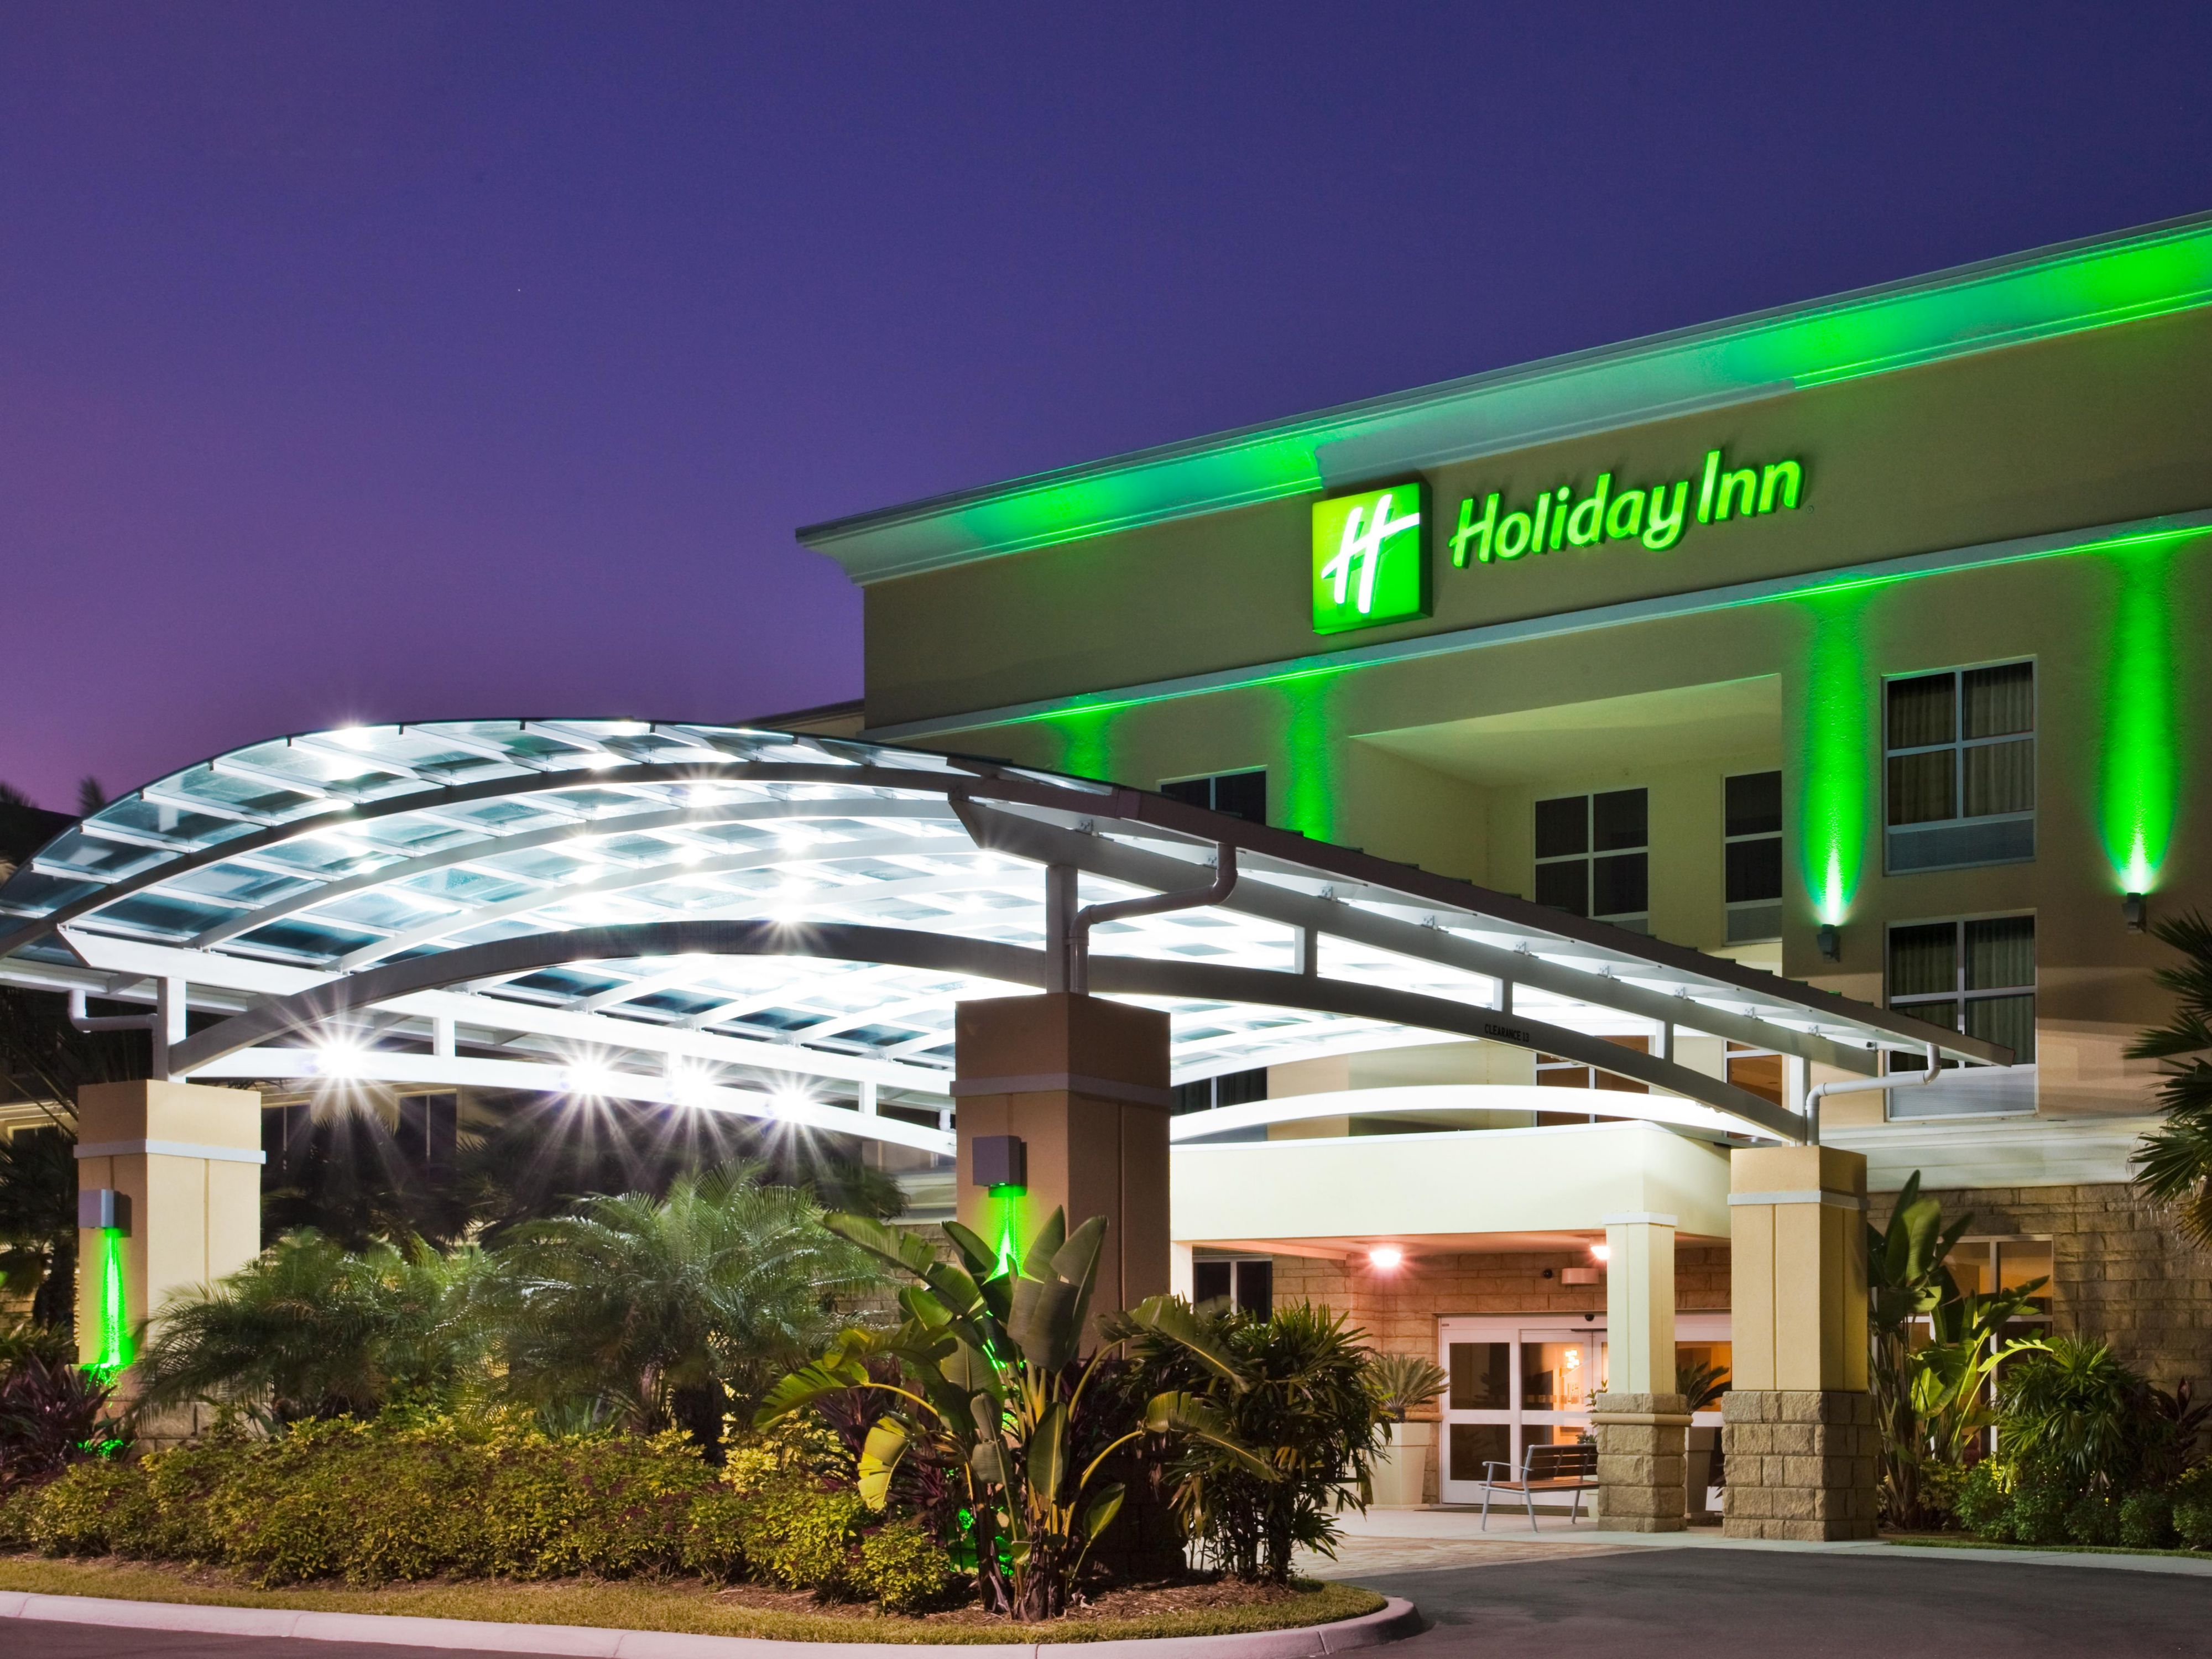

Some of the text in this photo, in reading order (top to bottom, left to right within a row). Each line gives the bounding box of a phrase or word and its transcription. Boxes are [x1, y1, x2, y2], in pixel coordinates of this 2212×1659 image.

[1321, 493, 1420, 614] H
[1447, 450, 1801, 568] Holiday Inn
[1484, 1024, 1530, 1042] CLEARANCE 13
